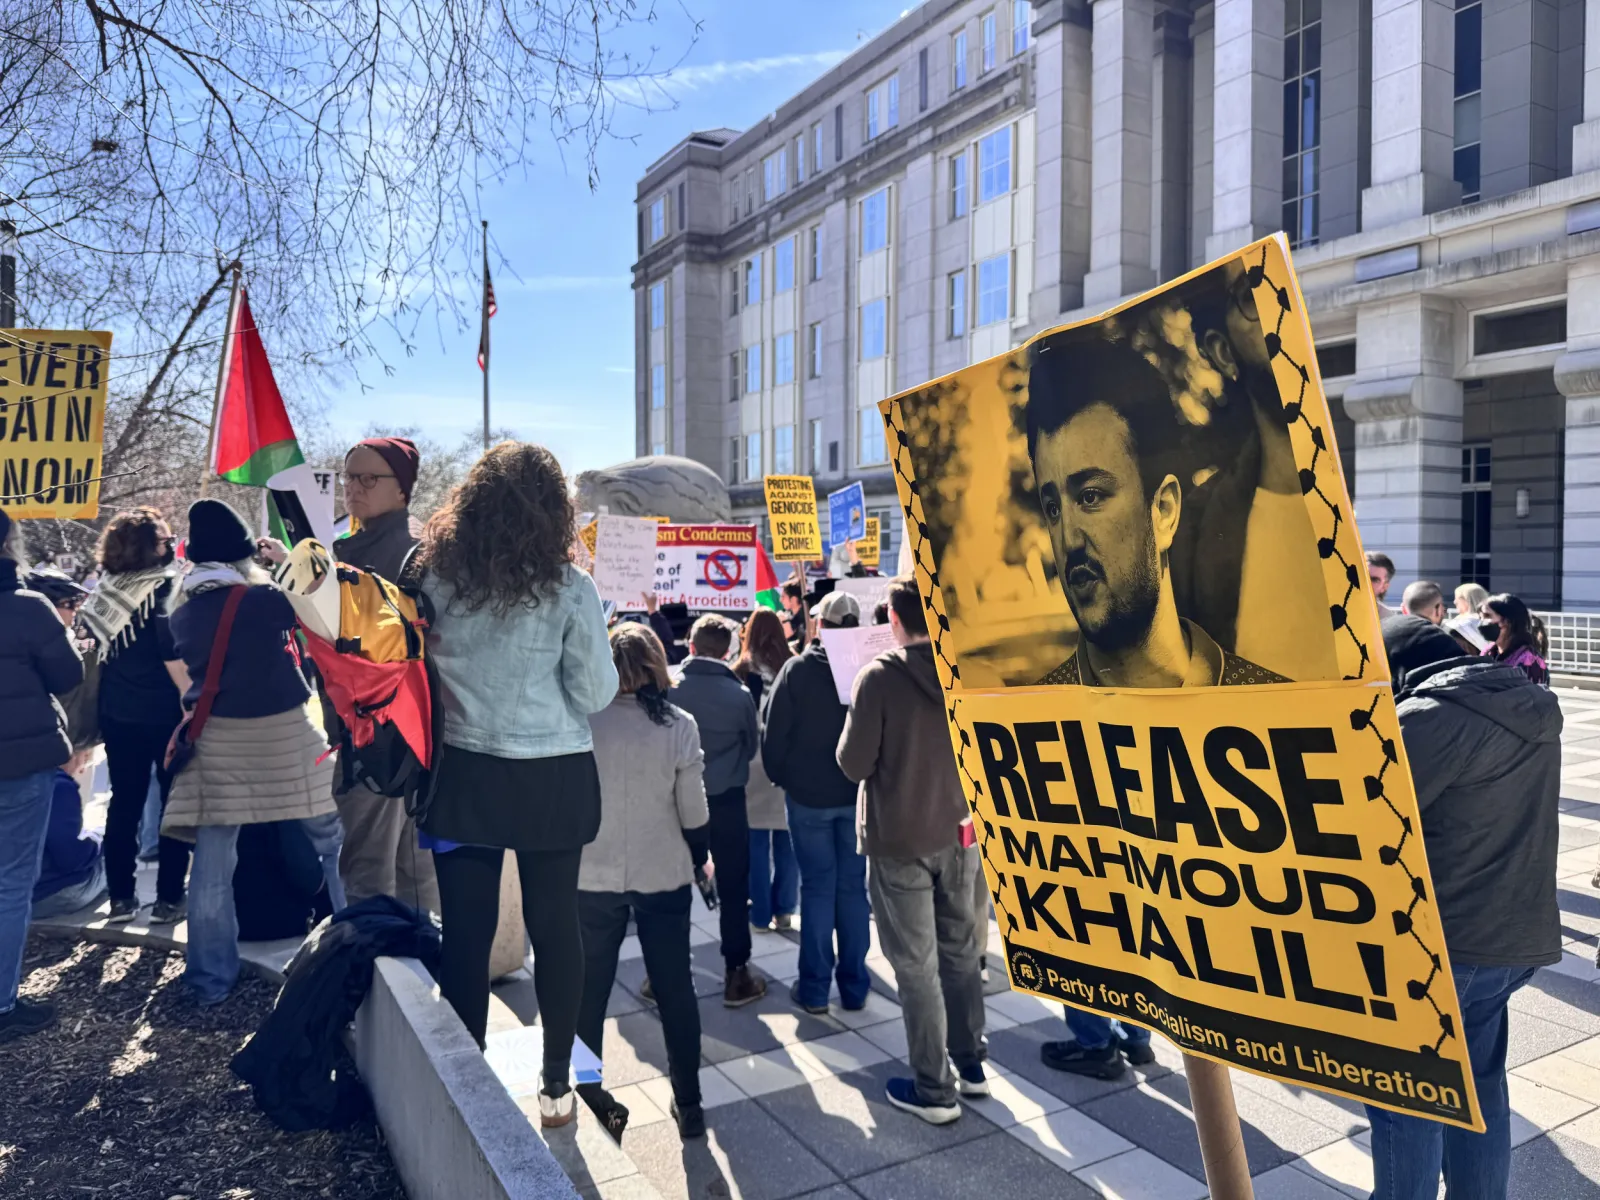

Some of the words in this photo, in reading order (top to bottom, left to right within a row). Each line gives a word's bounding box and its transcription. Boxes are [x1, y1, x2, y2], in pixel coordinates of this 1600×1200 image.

[3, 458, 94, 505] NOW
[767, 479, 812, 491] PROTESTING
[770, 492, 812, 500] AGAINST
[771, 501, 815, 515] GENOCIDE
[679, 527, 753, 542] Condemns
[776, 522, 787, 535] IS
[789, 522, 805, 535] NOT
[809, 522, 815, 535] A
[782, 537, 815, 550] CRIME!
[668, 564, 681, 576] of
[654, 580, 680, 590] ael"
[680, 593, 749, 607] Atrocities
[973, 720, 1362, 860] RELEASE
[999, 825, 1376, 925] MAHMOUD
[1013, 876, 1397, 1021] KHALIL!
[1020, 964, 1035, 979] PSL
[1046, 968, 1095, 1003] Party
[1099, 984, 1129, 1008] for
[1134, 991, 1229, 1050] Socialism
[1235, 1037, 1287, 1066] and
[1294, 1046, 1462, 1109] Liberation
